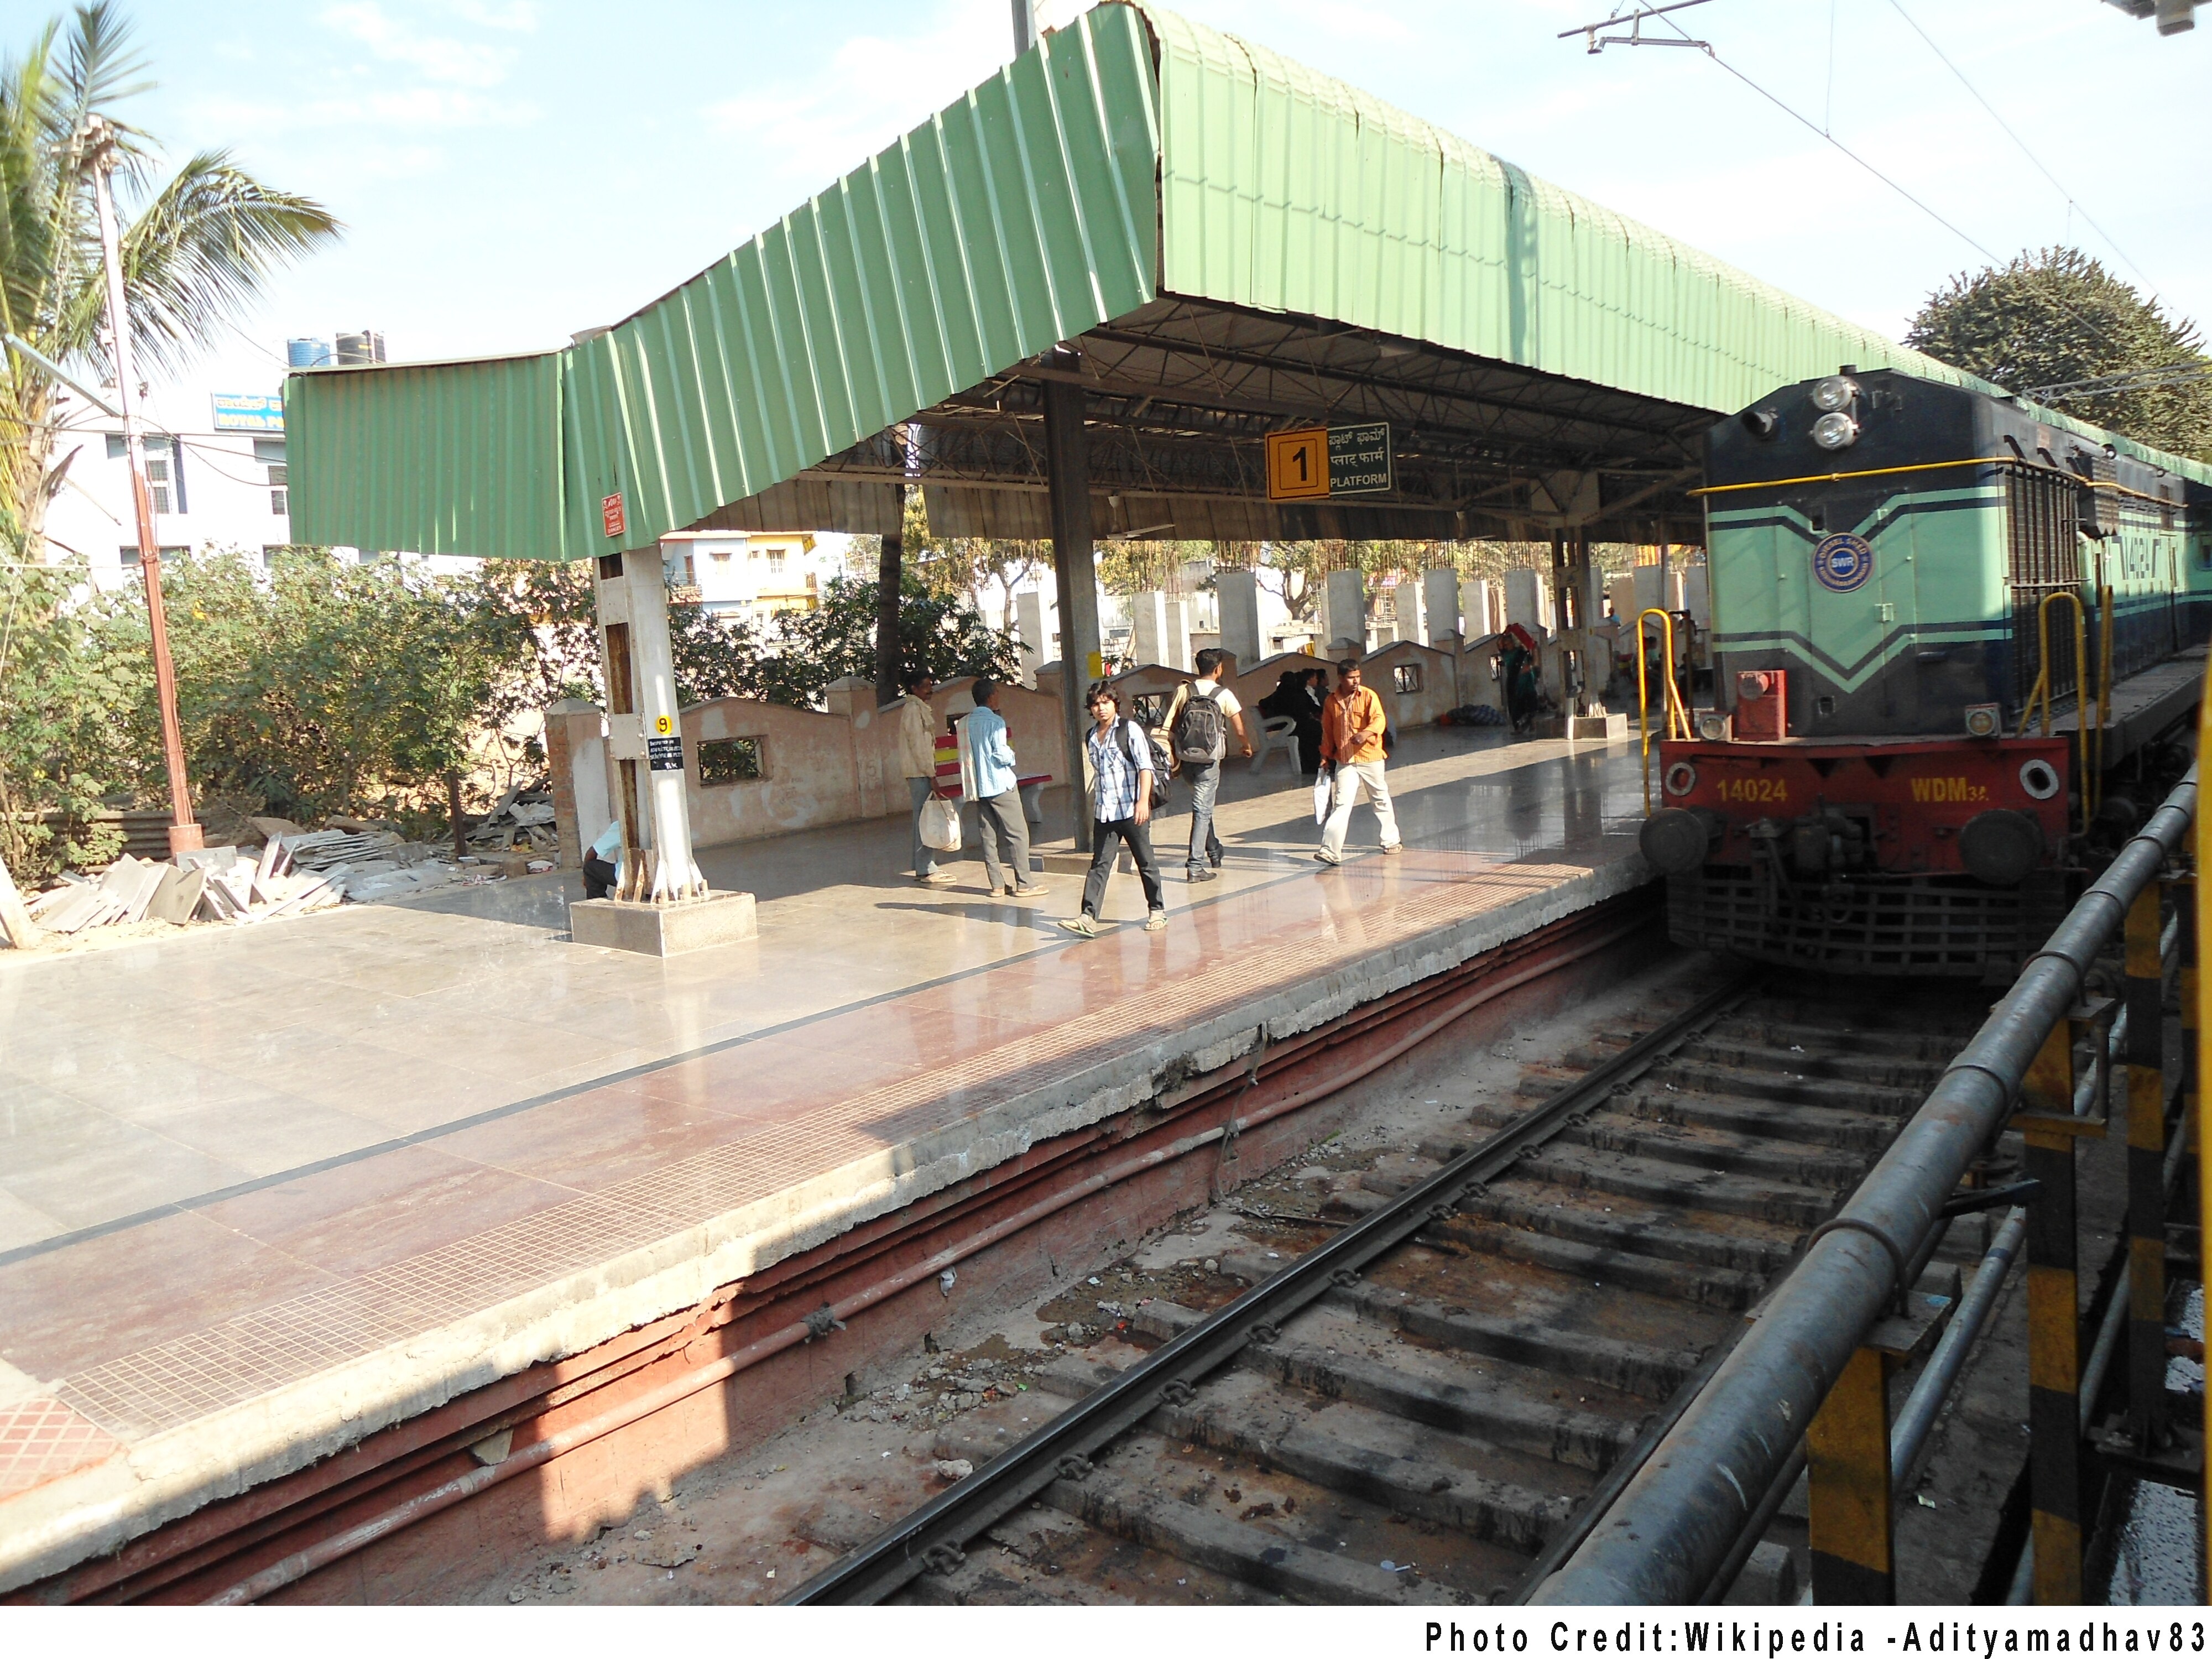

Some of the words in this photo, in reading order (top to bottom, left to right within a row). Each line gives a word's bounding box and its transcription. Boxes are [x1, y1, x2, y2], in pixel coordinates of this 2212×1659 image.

[1359, 447, 1384, 462] फार्म
[1293, 447, 1307, 481] 1
[1330, 473, 1387, 487] PLATFORM
[1831, 557, 1854, 568] SWR
[659, 718, 668, 732] 9
[1717, 779, 1788, 802] 14024
